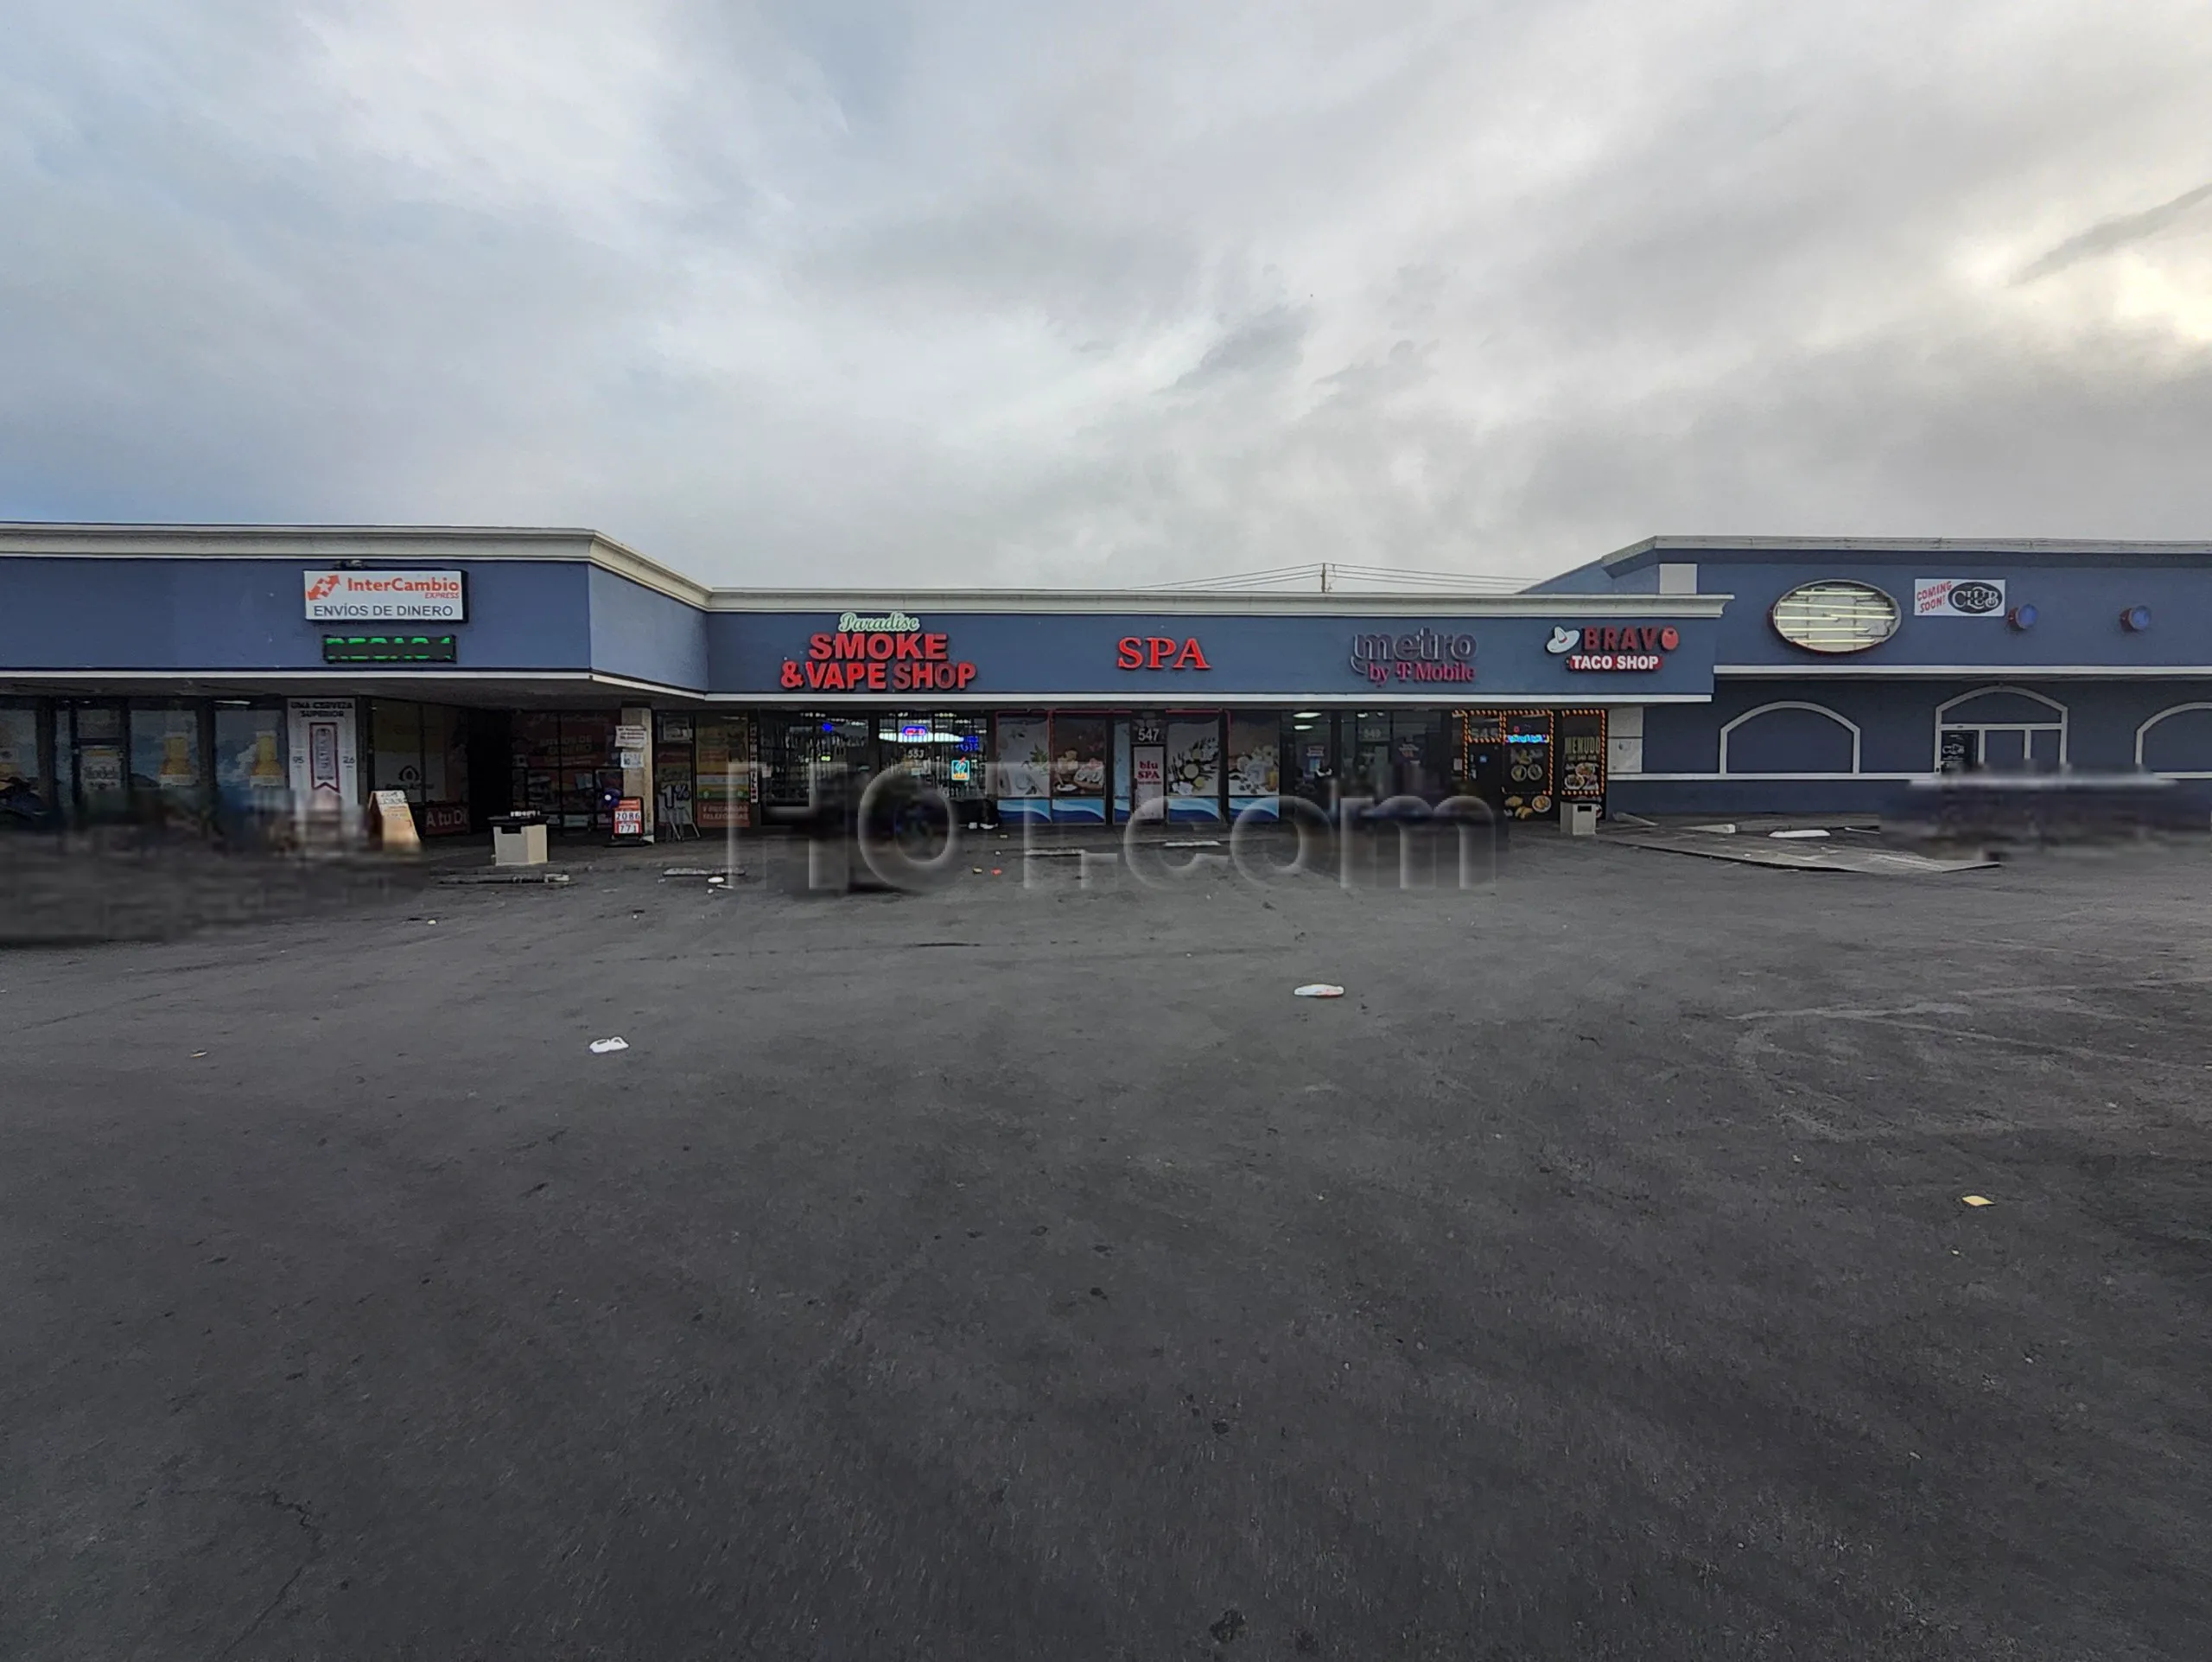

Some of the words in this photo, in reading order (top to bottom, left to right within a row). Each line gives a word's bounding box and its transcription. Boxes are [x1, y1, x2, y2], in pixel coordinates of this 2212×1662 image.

[347, 576, 460, 592] InterCambio
[1916, 581, 1953, 602] COMING
[1919, 594, 1946, 614] SOON!
[1952, 586, 1999, 609] CLUB
[372, 605, 392, 616] DE
[397, 605, 454, 616] DINERO
[838, 611, 920, 632] Paradise
[809, 633, 948, 660] SMOKE
[1117, 636, 1211, 669] SPA
[1351, 627, 1478, 674] metro
[1571, 655, 1612, 670] TACO
[1616, 655, 1660, 670] SHOP
[892, 660, 976, 690] SHOP
[1369, 662, 1389, 685] by
[1138, 728, 1160, 742] 547
[907, 749, 925, 759] 553
[426, 811, 436, 827] A
[438, 811, 451, 826] tu
